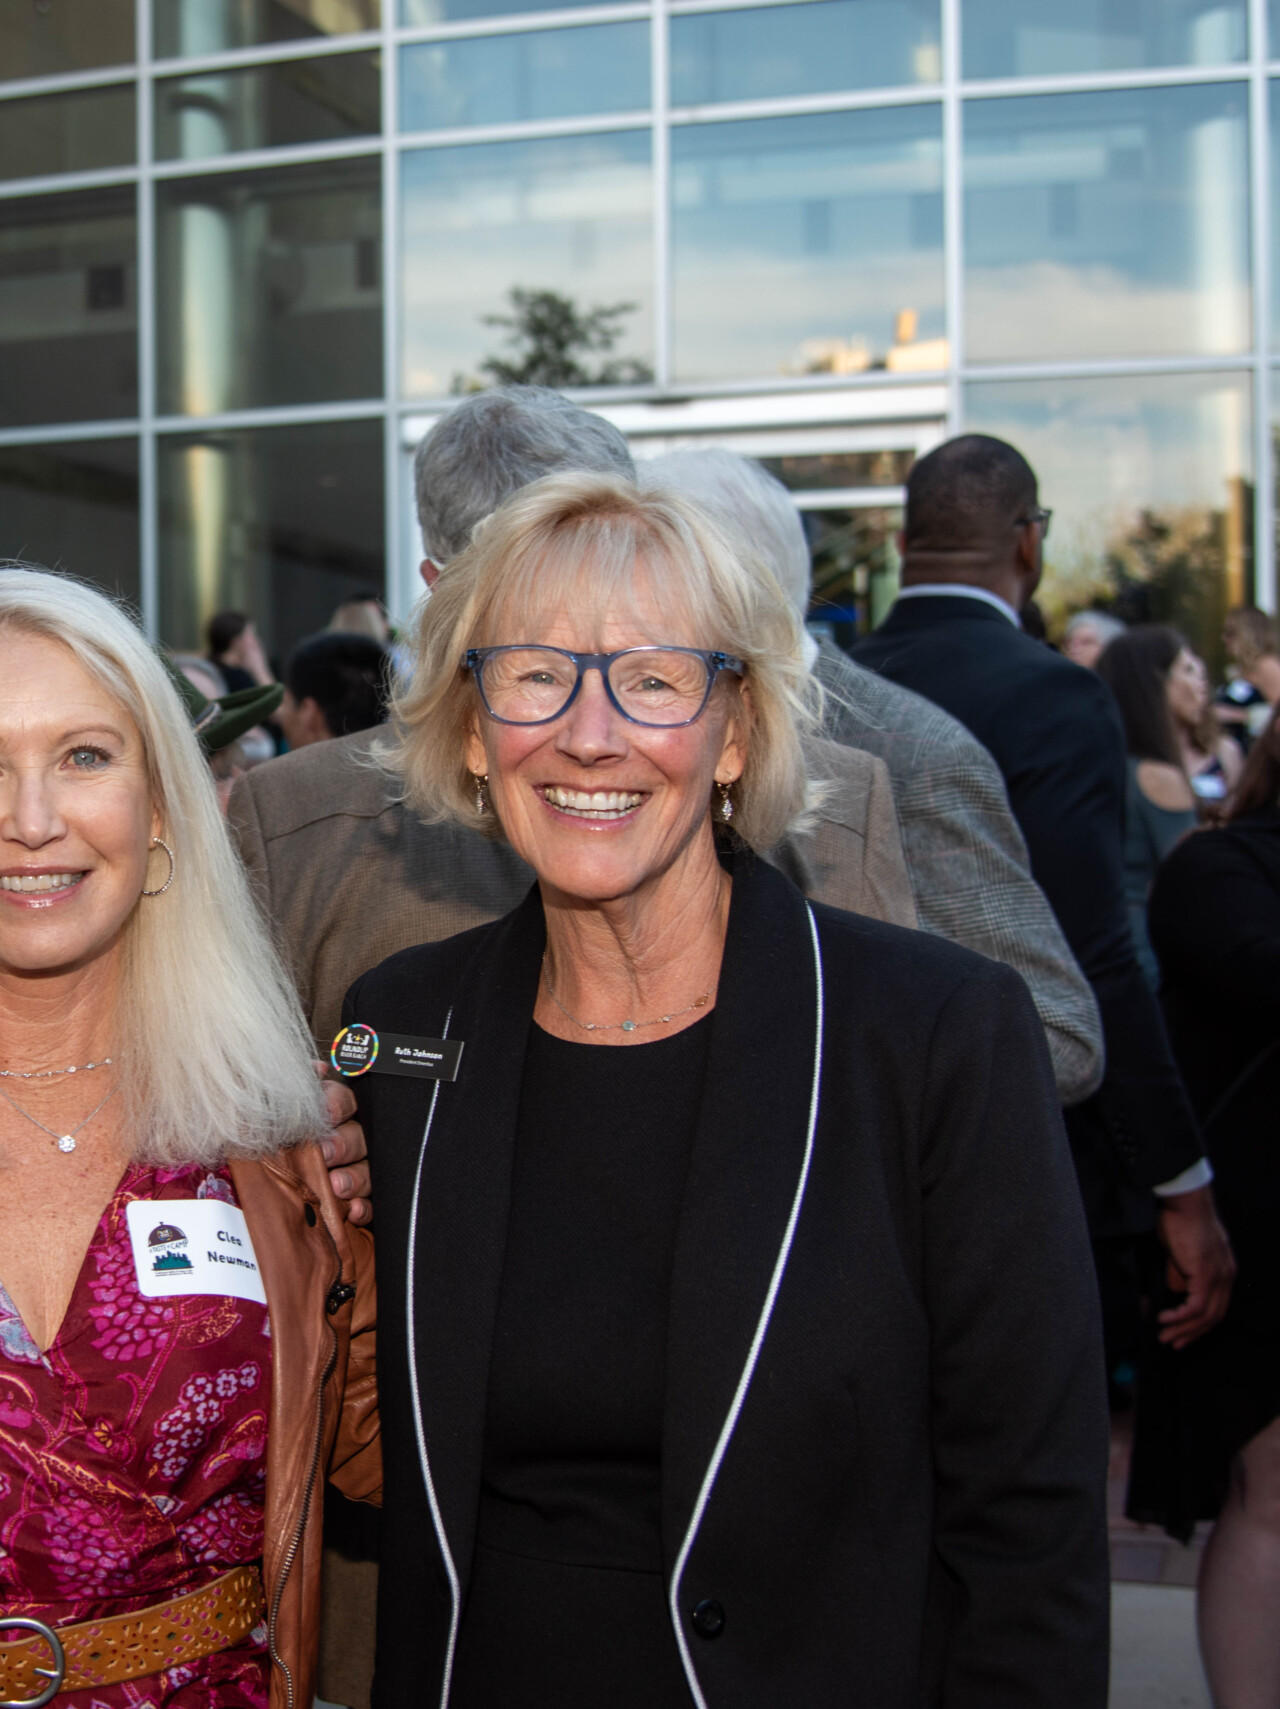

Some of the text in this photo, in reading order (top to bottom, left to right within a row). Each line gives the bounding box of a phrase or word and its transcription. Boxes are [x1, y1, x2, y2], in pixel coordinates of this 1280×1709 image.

[342, 1044, 369, 1054] ROUNDUP
[394, 1046, 443, 1060] Ruth Johnson
[170, 1238, 189, 1250] CAMP
[217, 1230, 243, 1247] Clea
[206, 1250, 257, 1271] Newman
